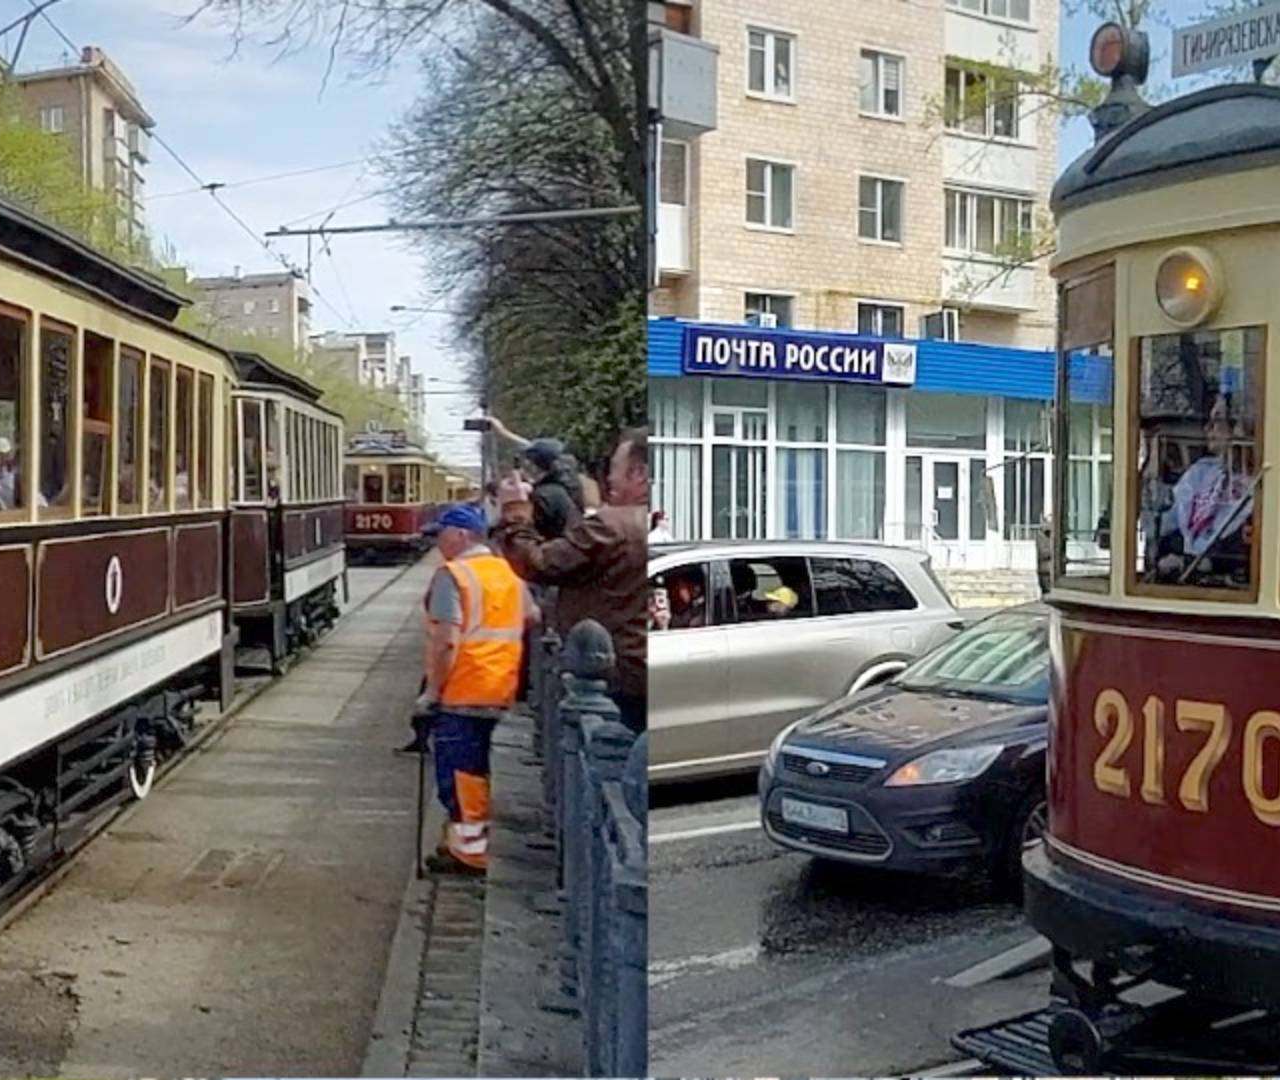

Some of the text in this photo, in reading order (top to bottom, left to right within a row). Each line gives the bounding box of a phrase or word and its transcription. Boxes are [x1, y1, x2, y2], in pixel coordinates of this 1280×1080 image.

[696, 336, 876, 374] ПОЧТА РОССИИ
[355, 513, 393, 529] 2170
